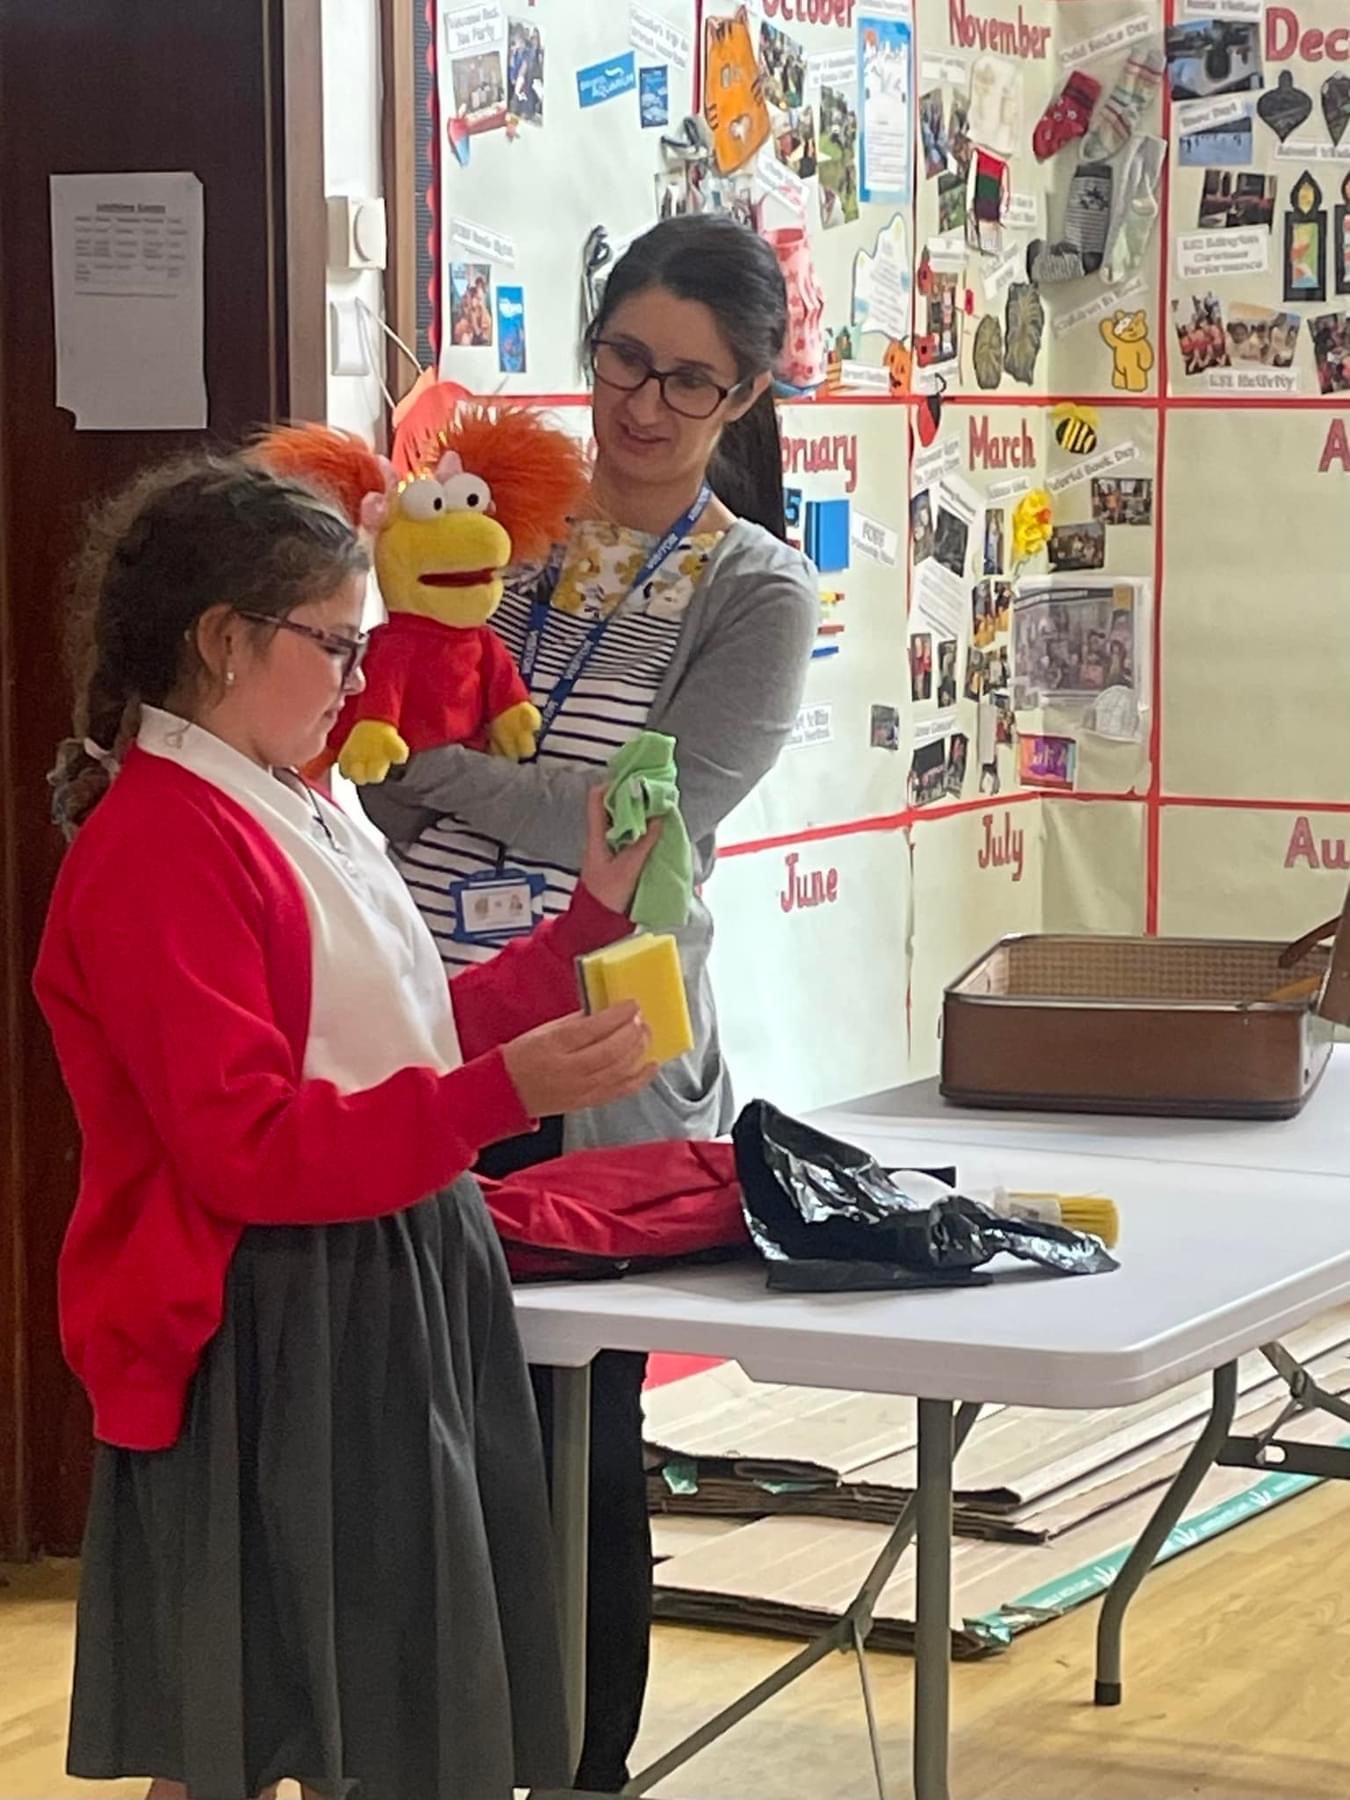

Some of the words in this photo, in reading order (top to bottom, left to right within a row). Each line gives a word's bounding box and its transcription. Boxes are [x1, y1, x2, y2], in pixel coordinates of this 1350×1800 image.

[950, 0, 1051, 59] November
[969, 415, 1036, 472] March
[978, 812, 1024, 882] July
[781, 852, 838, 913] June
